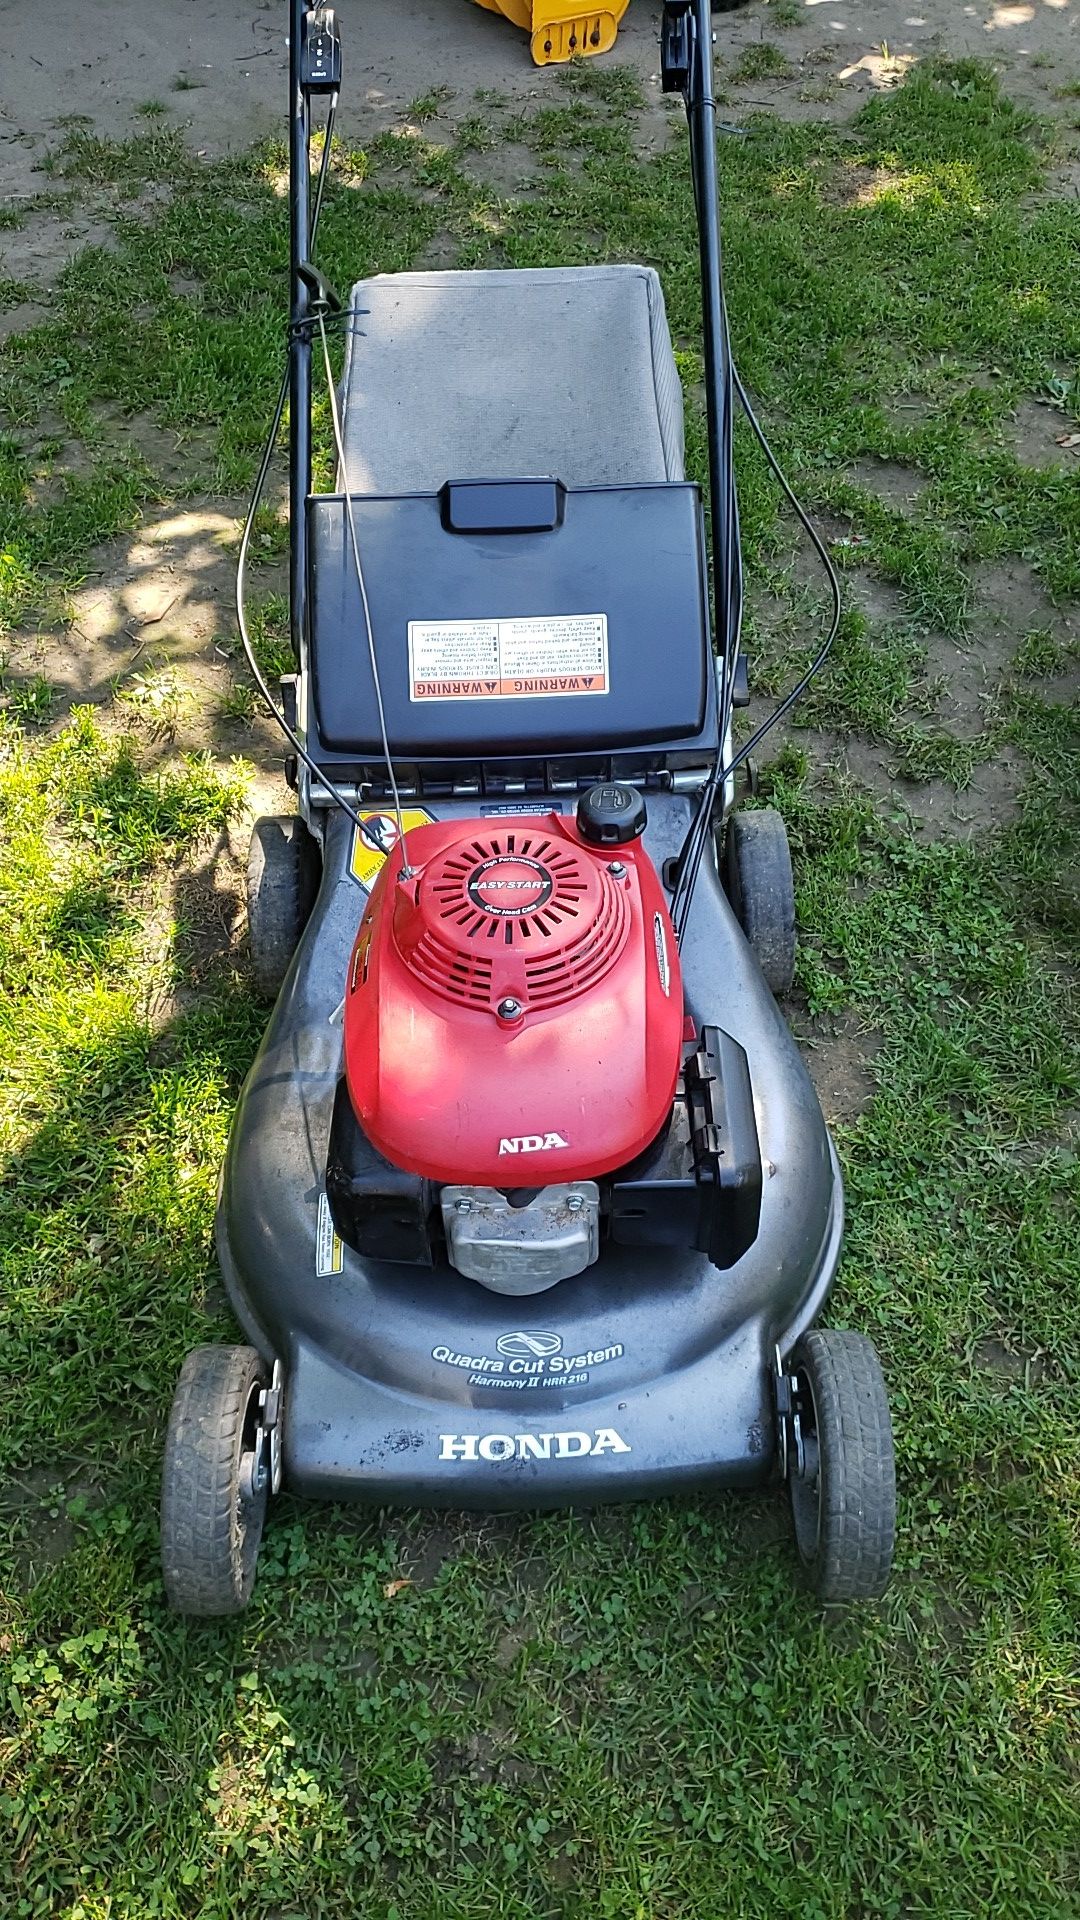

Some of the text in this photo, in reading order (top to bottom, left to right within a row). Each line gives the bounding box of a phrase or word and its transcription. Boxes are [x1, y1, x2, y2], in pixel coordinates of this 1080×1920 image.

[417, 682, 482, 694] WARNING
[514, 678, 579, 691] WARNING
[483, 860, 497, 869] High
[470, 881, 550, 890] EASY START
[485, 905, 501, 914] Over
[432, 1344, 623, 1373] Quadra Cut System
[469, 1373, 587, 1389] Harmony II HRR 216
[438, 1428, 632, 1461] HONDA
